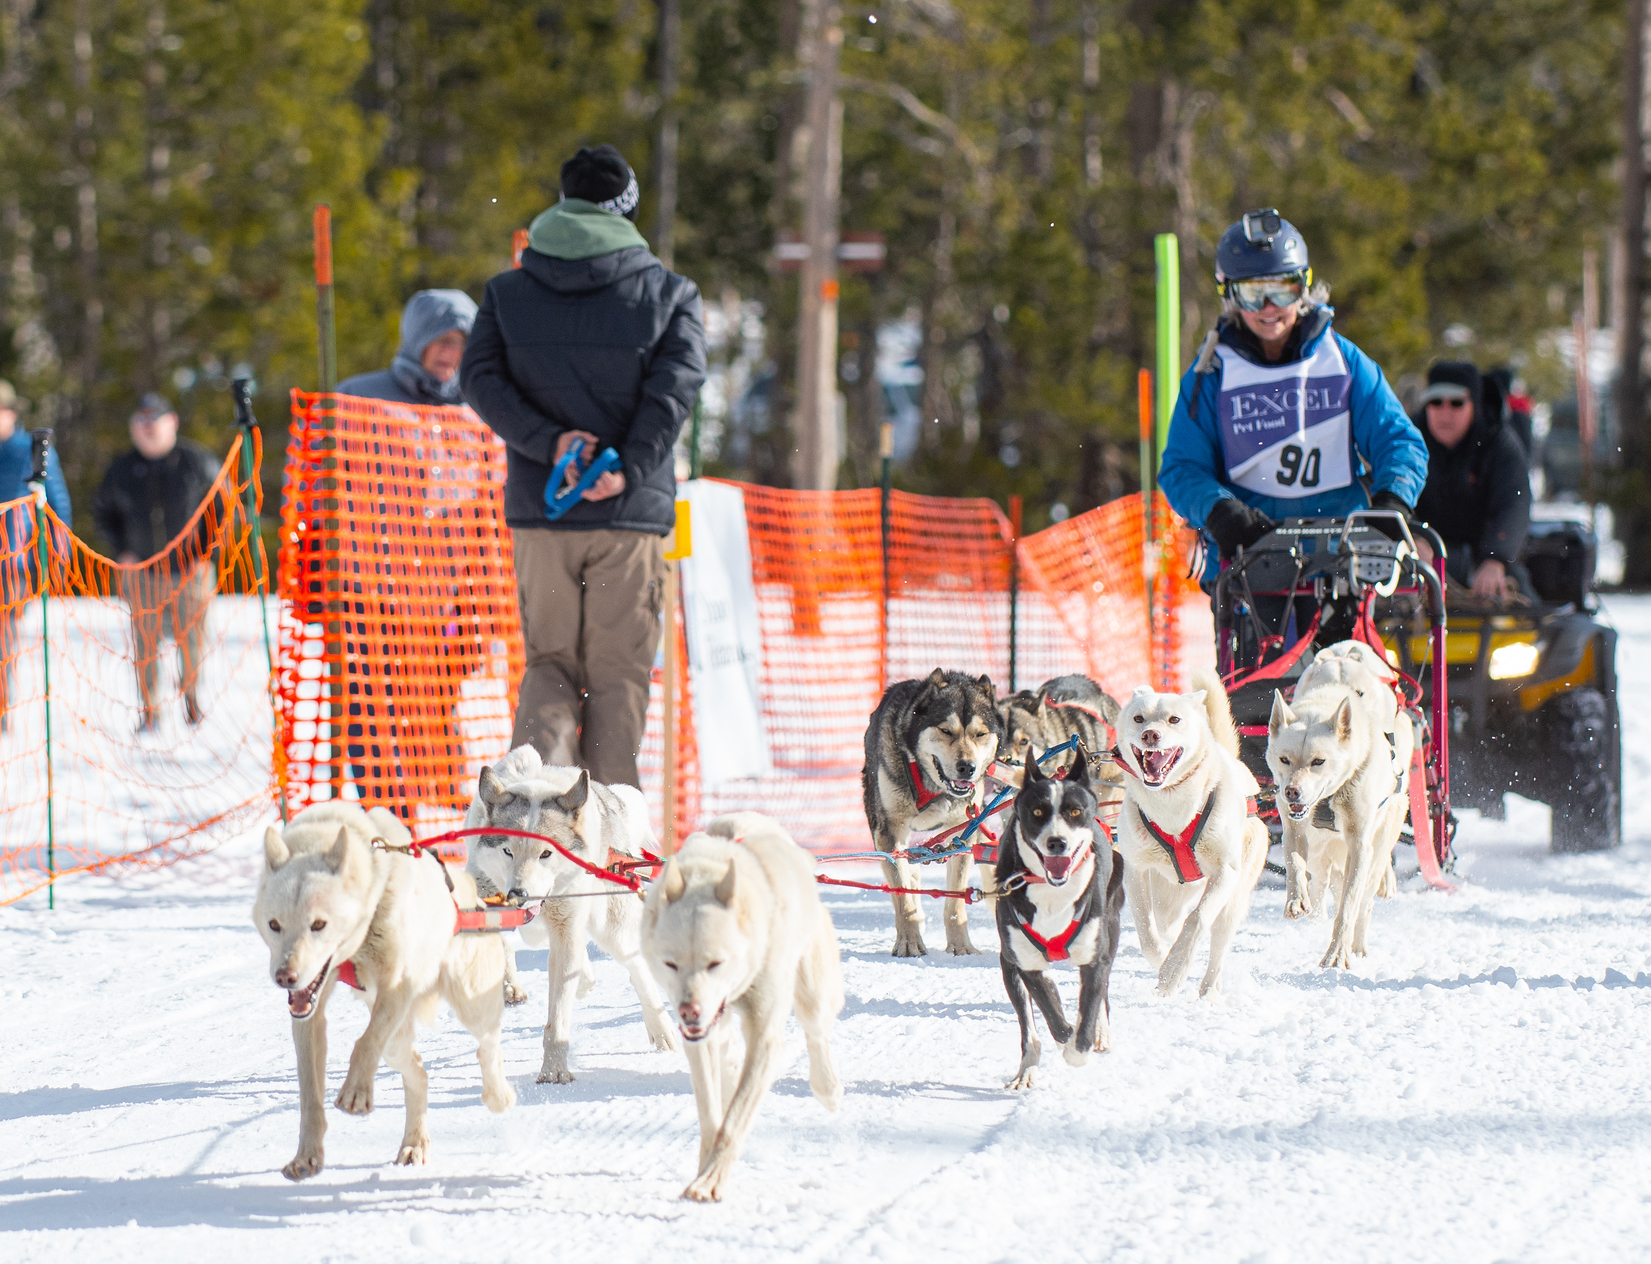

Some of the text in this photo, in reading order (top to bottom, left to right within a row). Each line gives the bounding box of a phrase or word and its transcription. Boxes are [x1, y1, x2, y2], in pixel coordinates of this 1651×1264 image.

[1230, 388, 1341, 421] EXCEL
[1233, 415, 1285, 435] Pet Food
[1276, 444, 1321, 488] 90
